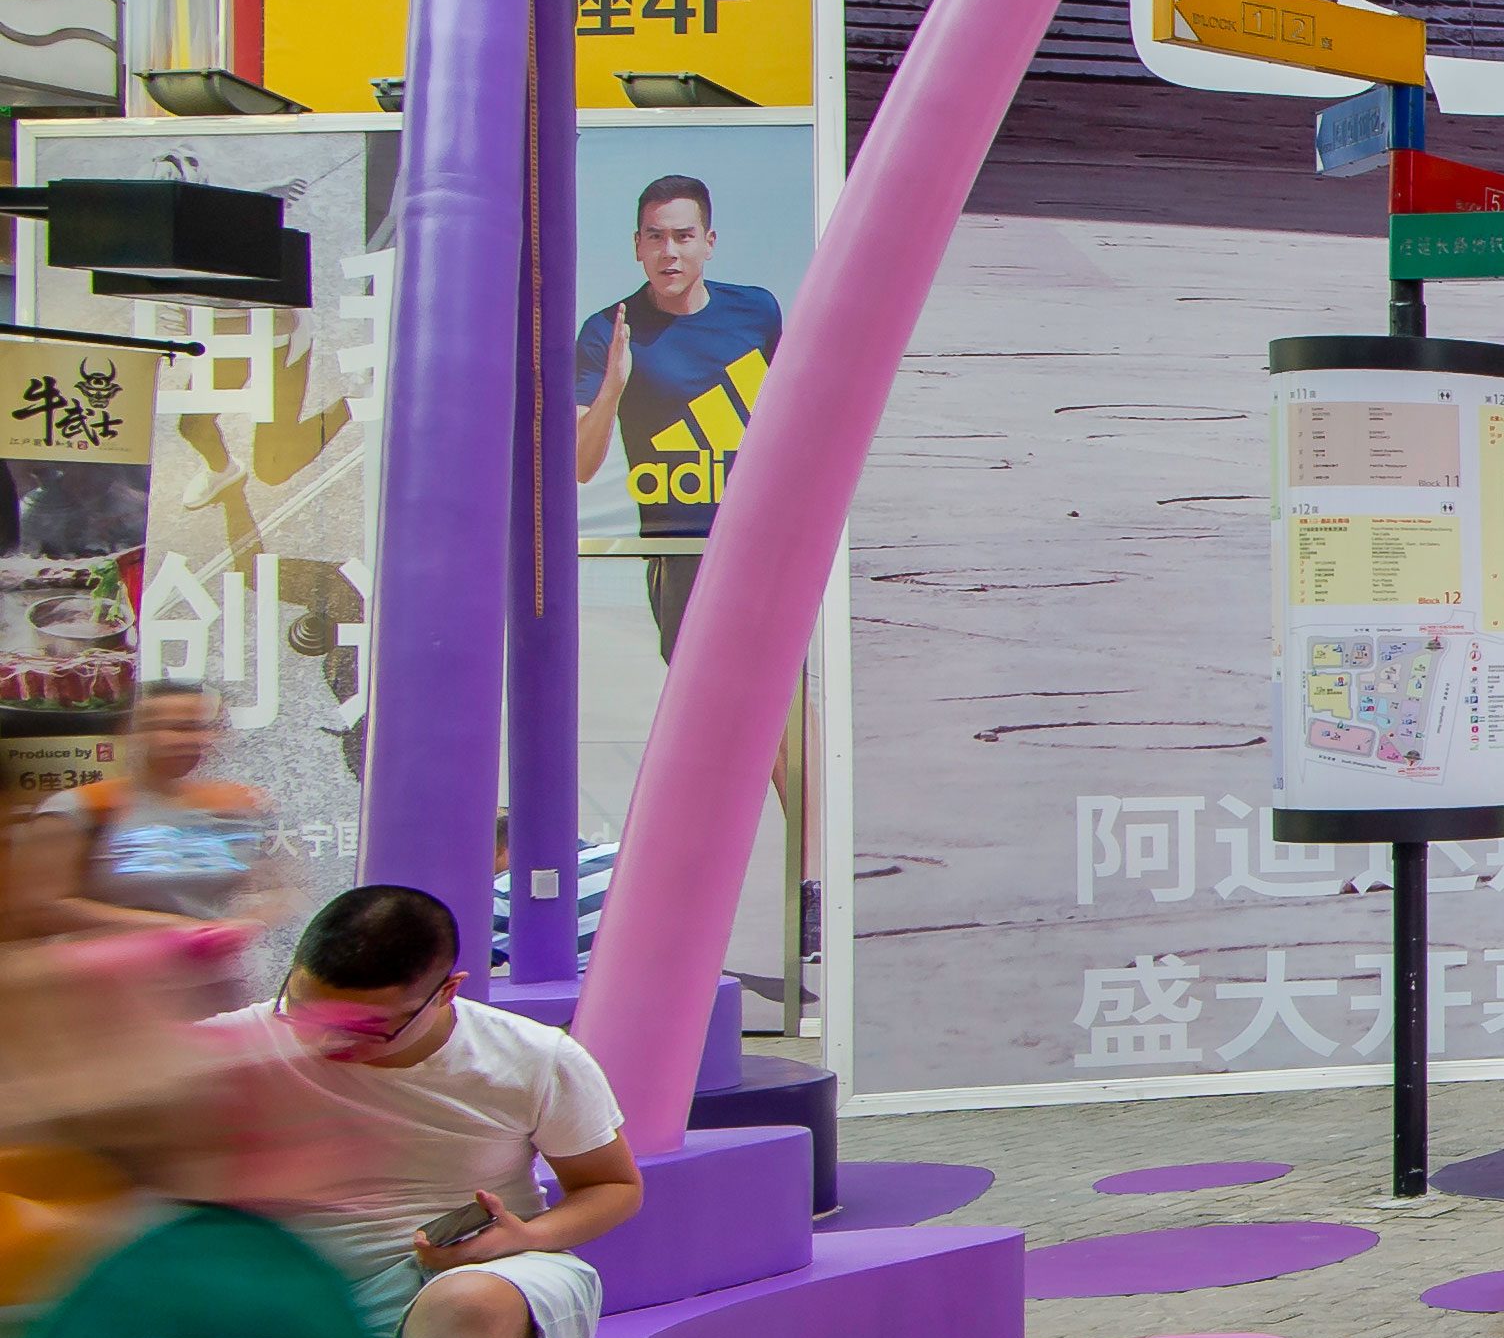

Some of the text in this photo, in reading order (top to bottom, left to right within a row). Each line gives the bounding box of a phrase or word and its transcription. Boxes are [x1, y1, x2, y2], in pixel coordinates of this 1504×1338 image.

[1191, 12, 1237, 32] BLOCK
[1252, 11, 1263, 32] 1
[1291, 18, 1306, 40] 2
[1491, 194, 1500, 211] 5
[11, 375, 124, 447] 牛武士
[1444, 591, 1461, 605] 12
[9, 747, 92, 762] Produce by
[20, 769, 104, 791] 6座3楼
